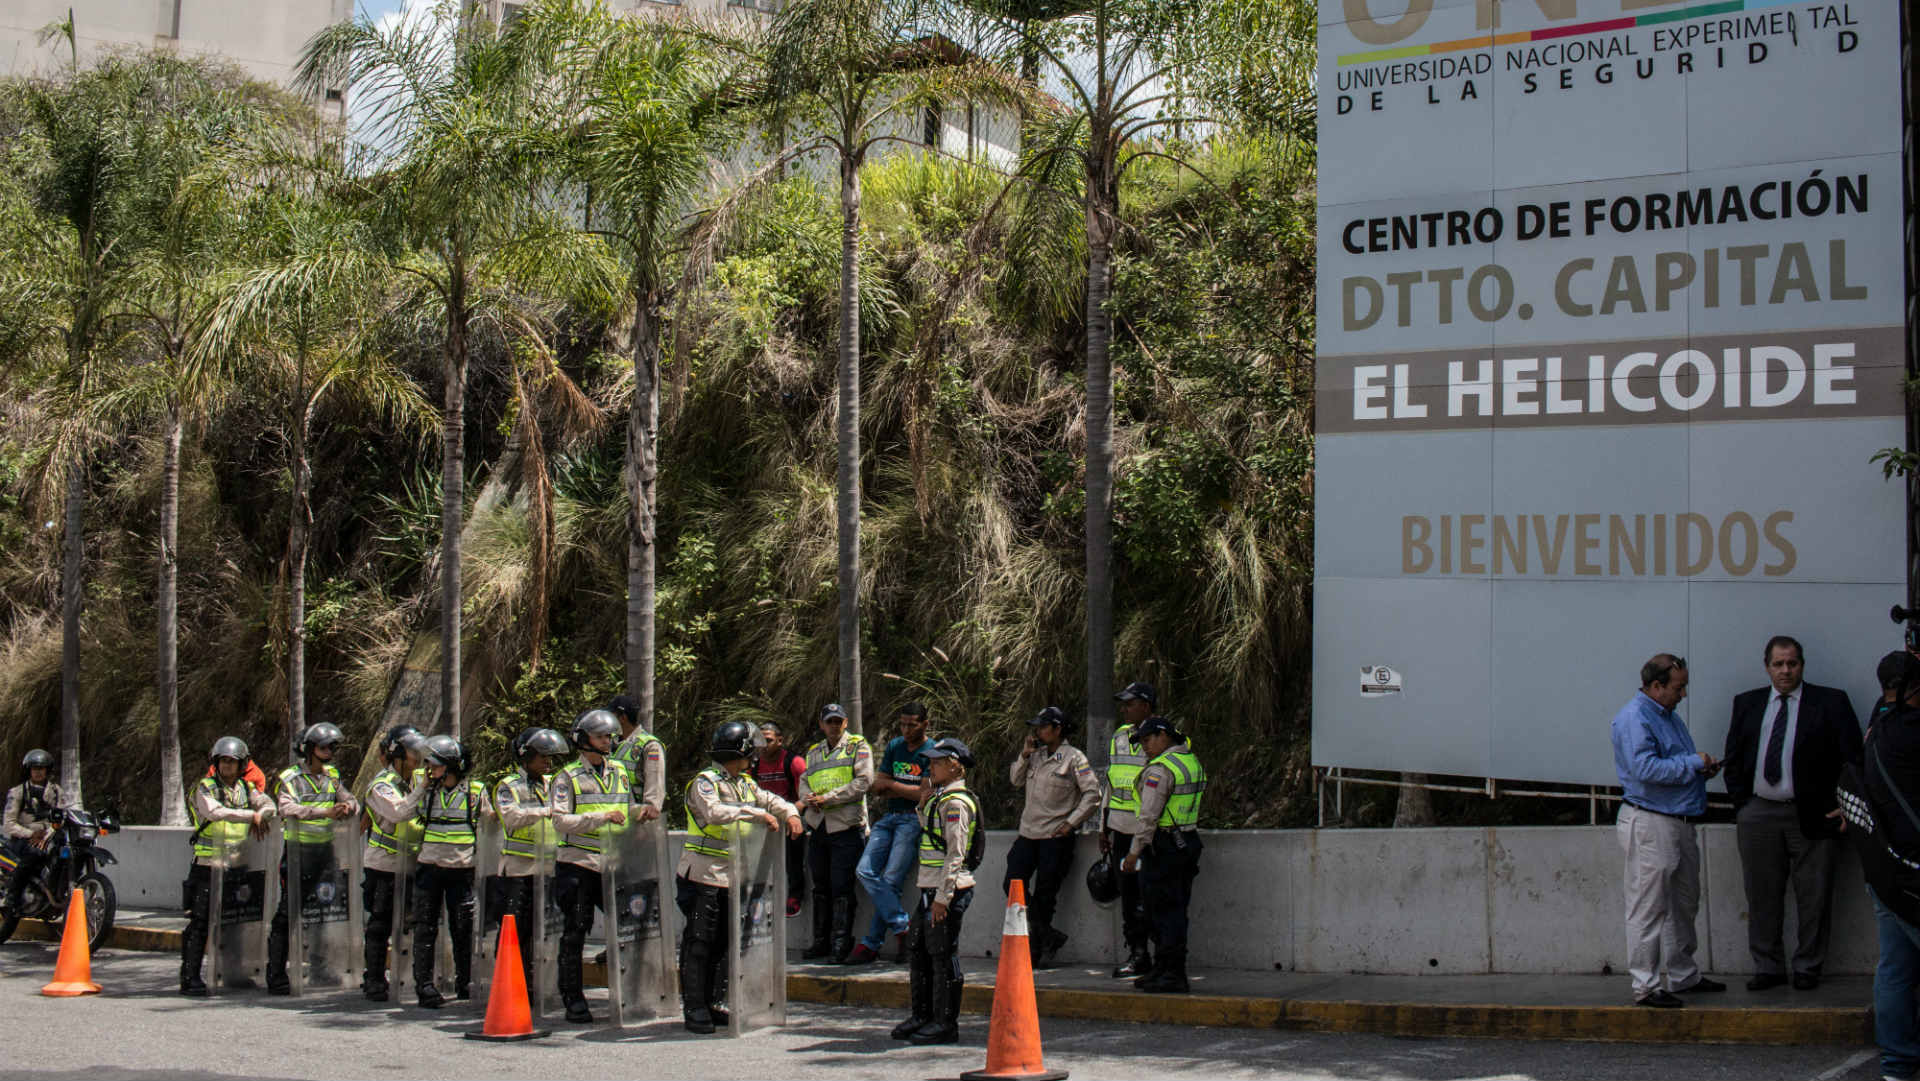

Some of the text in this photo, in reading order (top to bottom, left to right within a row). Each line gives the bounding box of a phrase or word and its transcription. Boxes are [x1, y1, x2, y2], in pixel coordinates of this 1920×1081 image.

[1337, 53, 1492, 91] UNIVERSIDAD
[1506, 35, 1638, 71] NACIONAL
[1337, 31, 1860, 115] DE LA SEGURIDD
[1343, 170, 1869, 254] CENTRO DE FORMACIÓN
[1342, 239, 1868, 332] DTTO. CAPITAL
[1353, 342, 1857, 421] EL HELICOIDE
[1401, 510, 1798, 577] BIENVENIDOS
